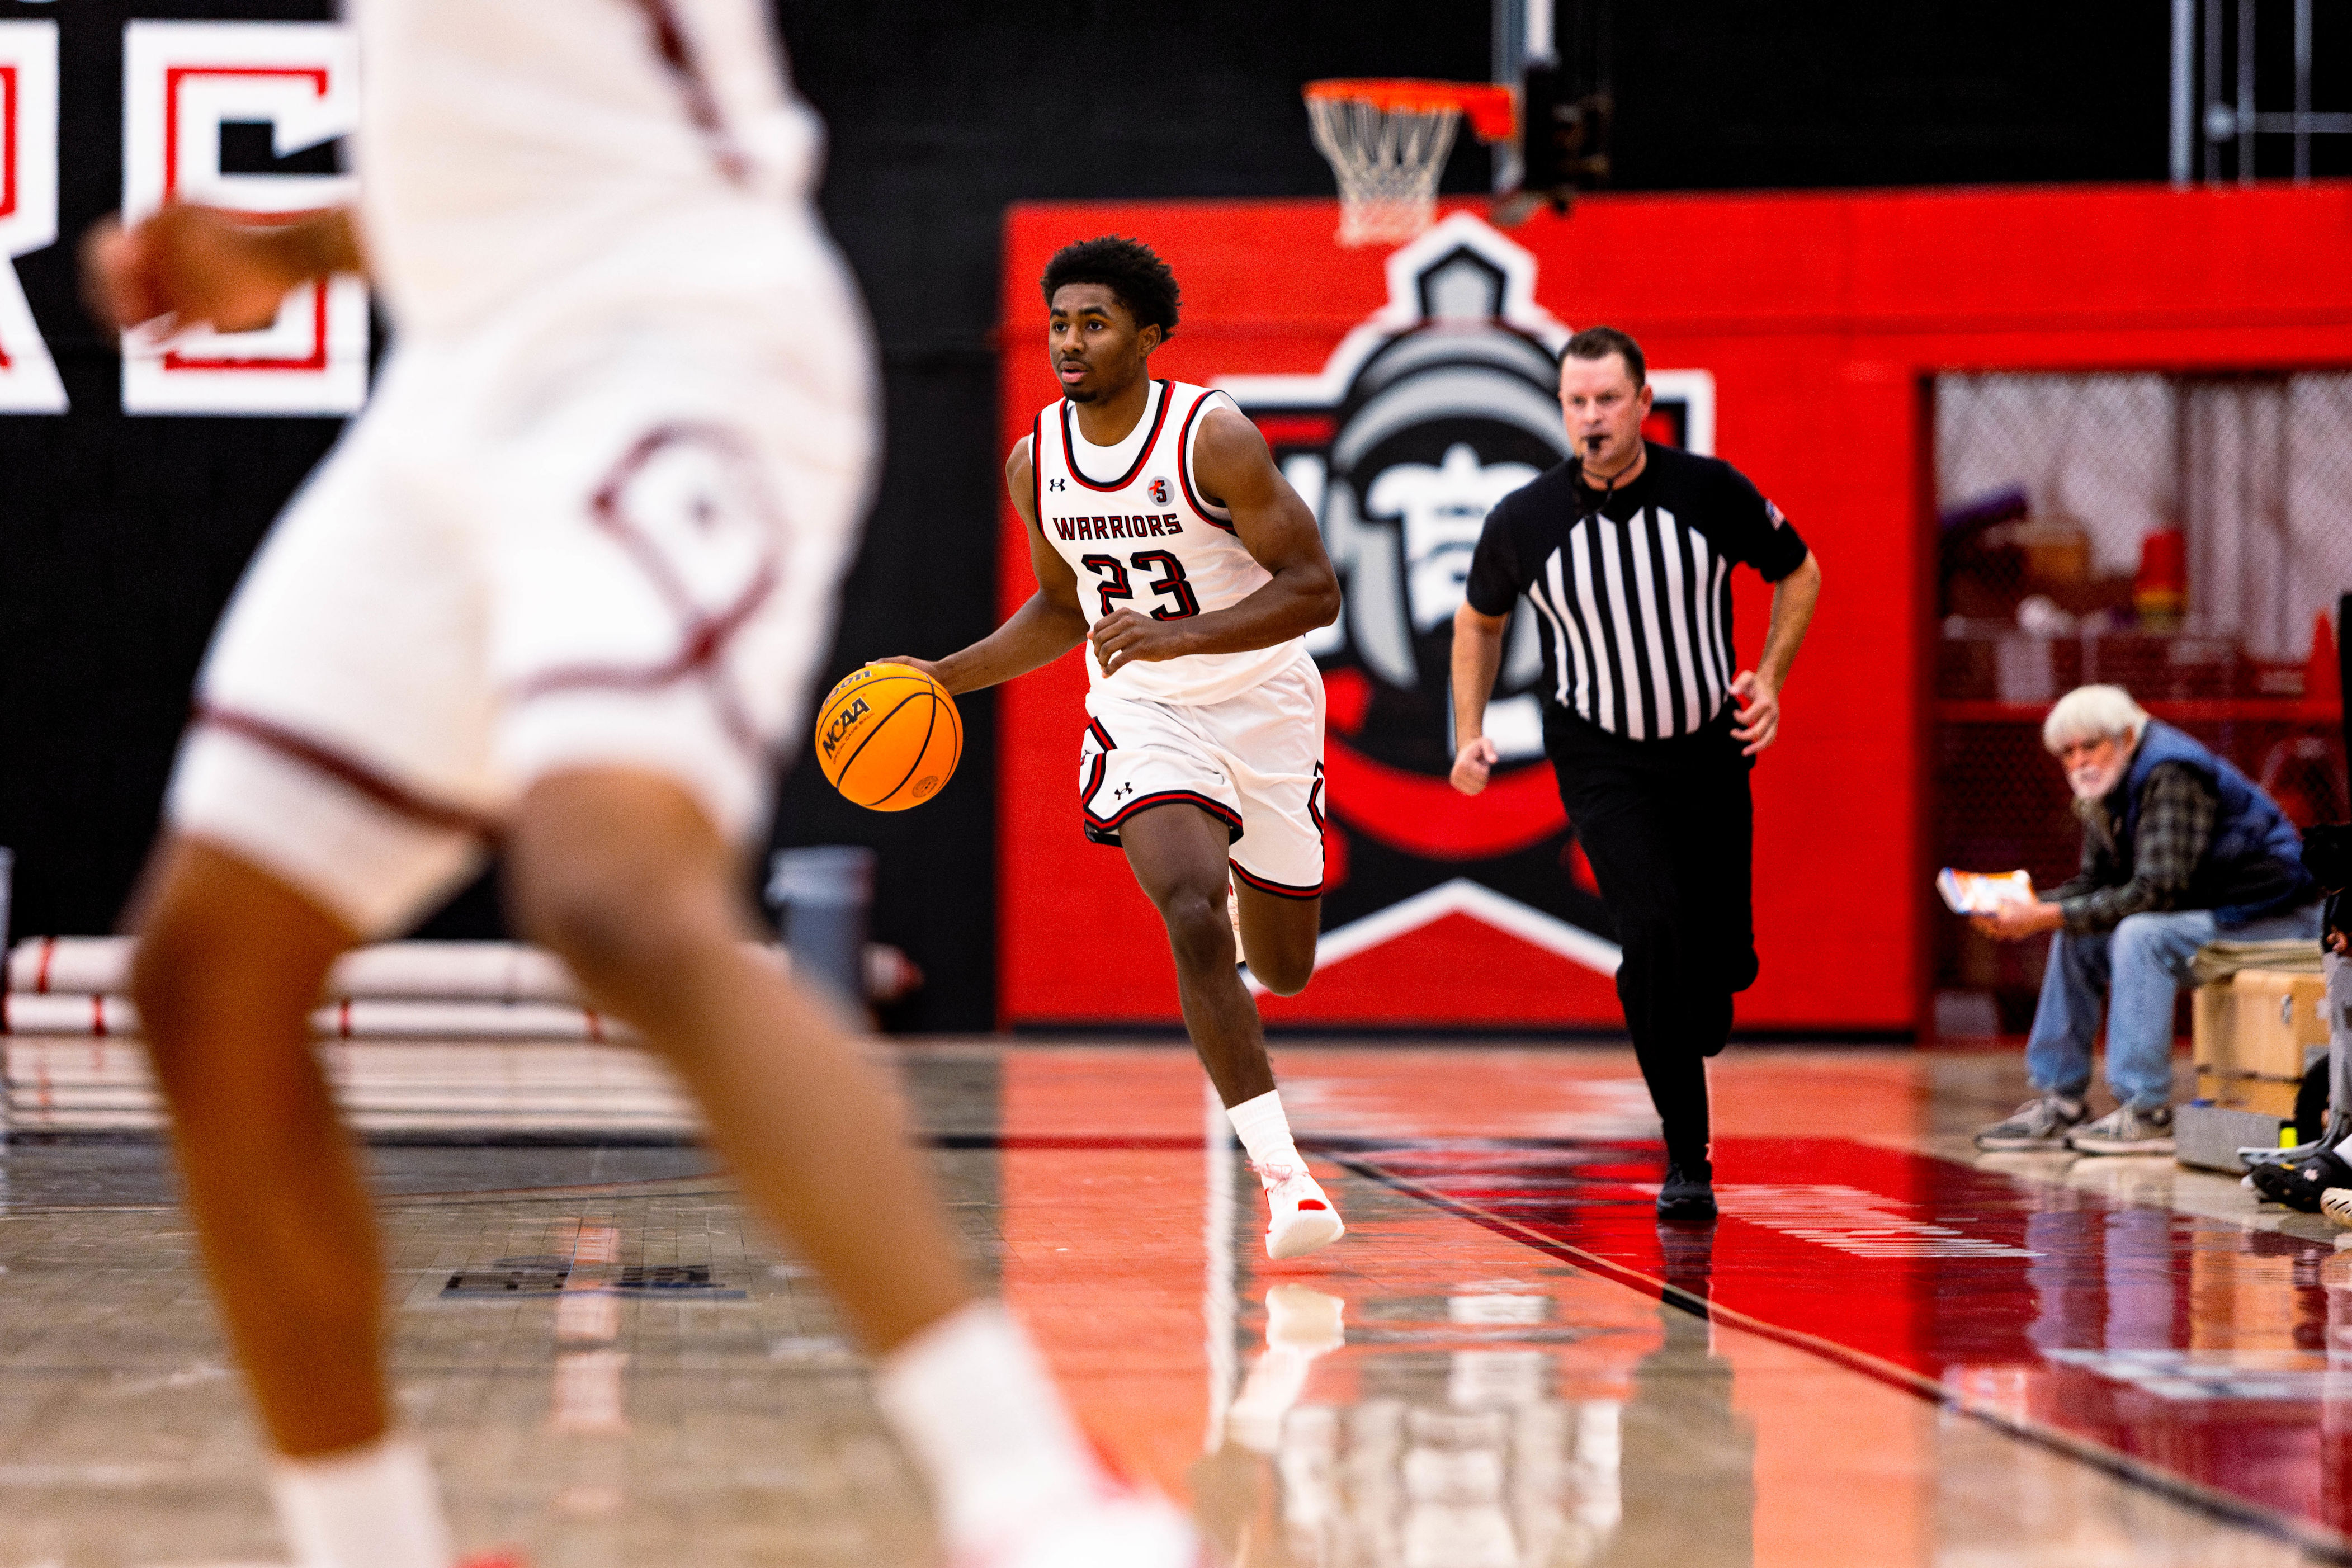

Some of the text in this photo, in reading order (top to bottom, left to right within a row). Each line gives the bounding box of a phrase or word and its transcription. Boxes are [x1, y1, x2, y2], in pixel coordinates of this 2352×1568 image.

[1052, 513, 1184, 540] WARRIORS
[1081, 549, 1201, 622] 23
[823, 696, 871, 760] NCAA
